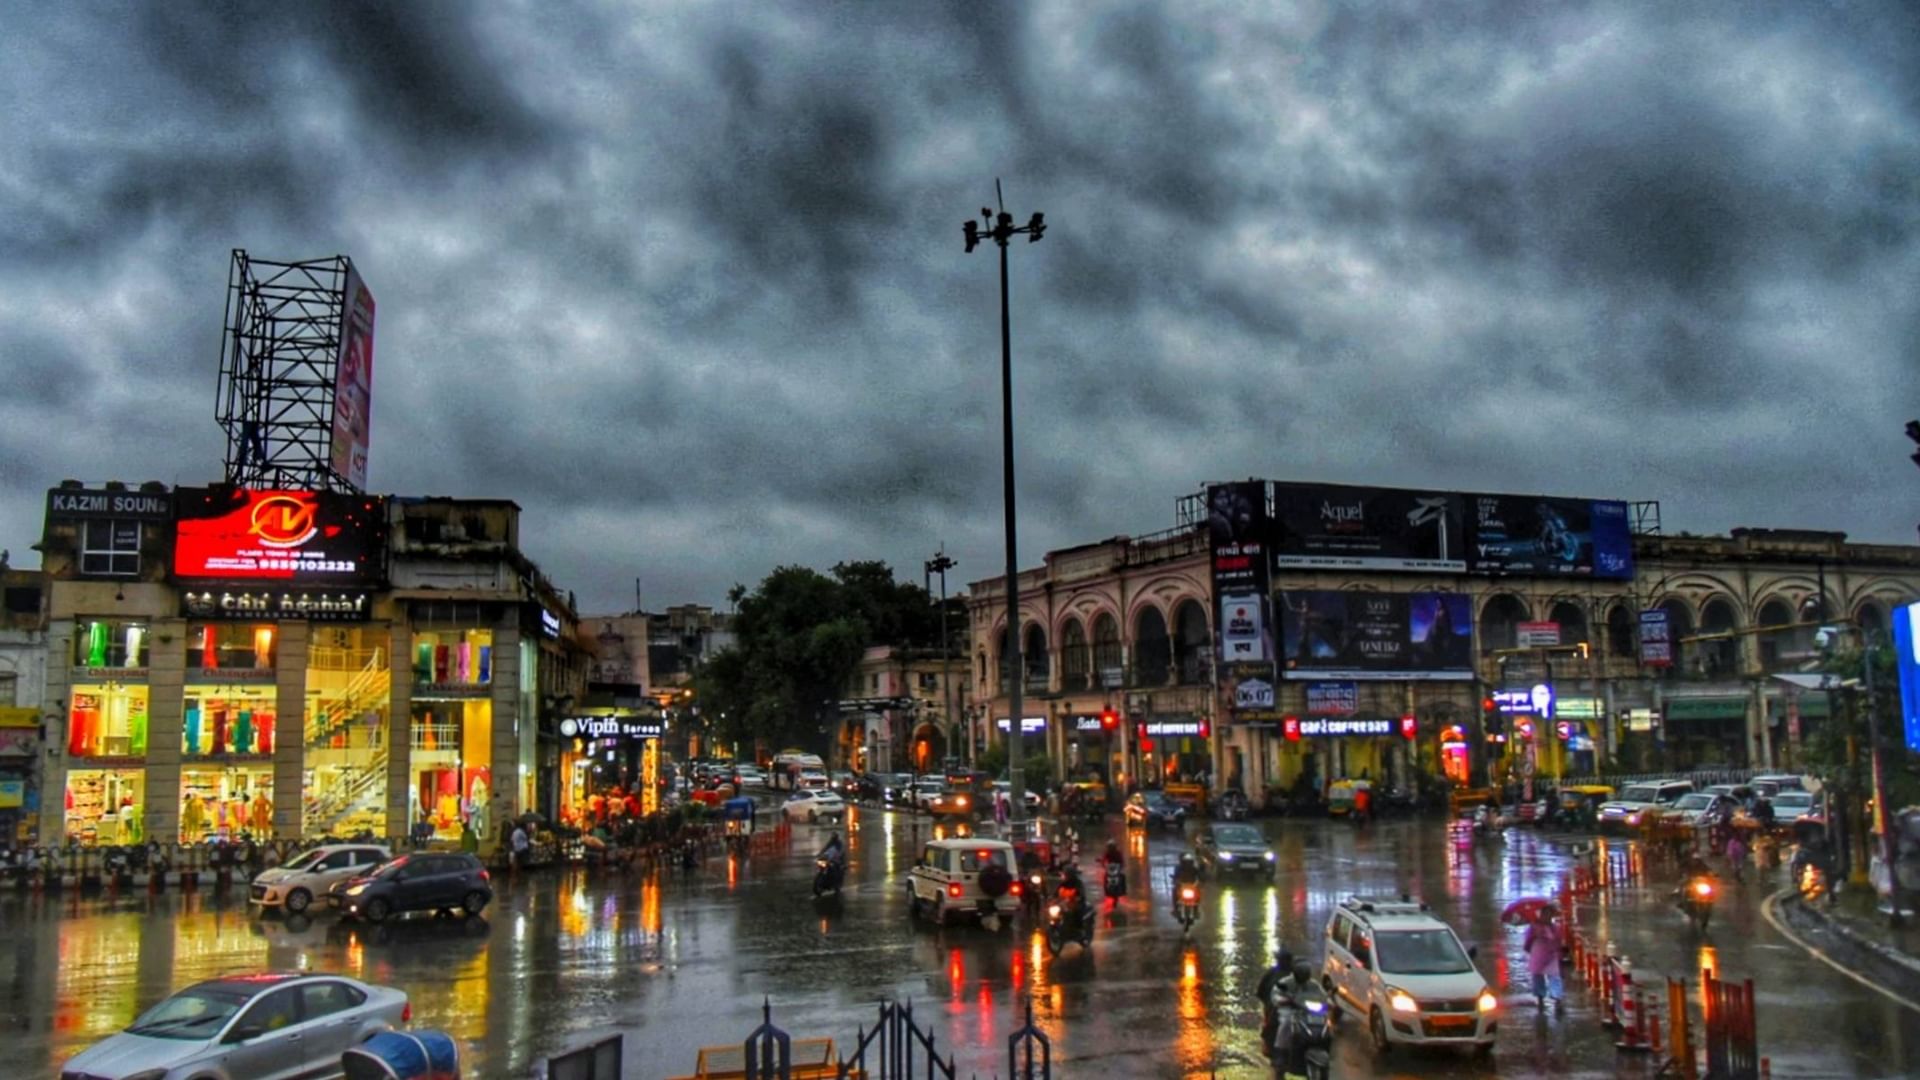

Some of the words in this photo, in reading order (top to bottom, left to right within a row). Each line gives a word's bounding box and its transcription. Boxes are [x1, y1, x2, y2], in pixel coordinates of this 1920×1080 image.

[53, 495, 108, 511] KAZMI
[1321, 500, 1364, 523] Aquel
[576, 716, 619, 737] Vipin
